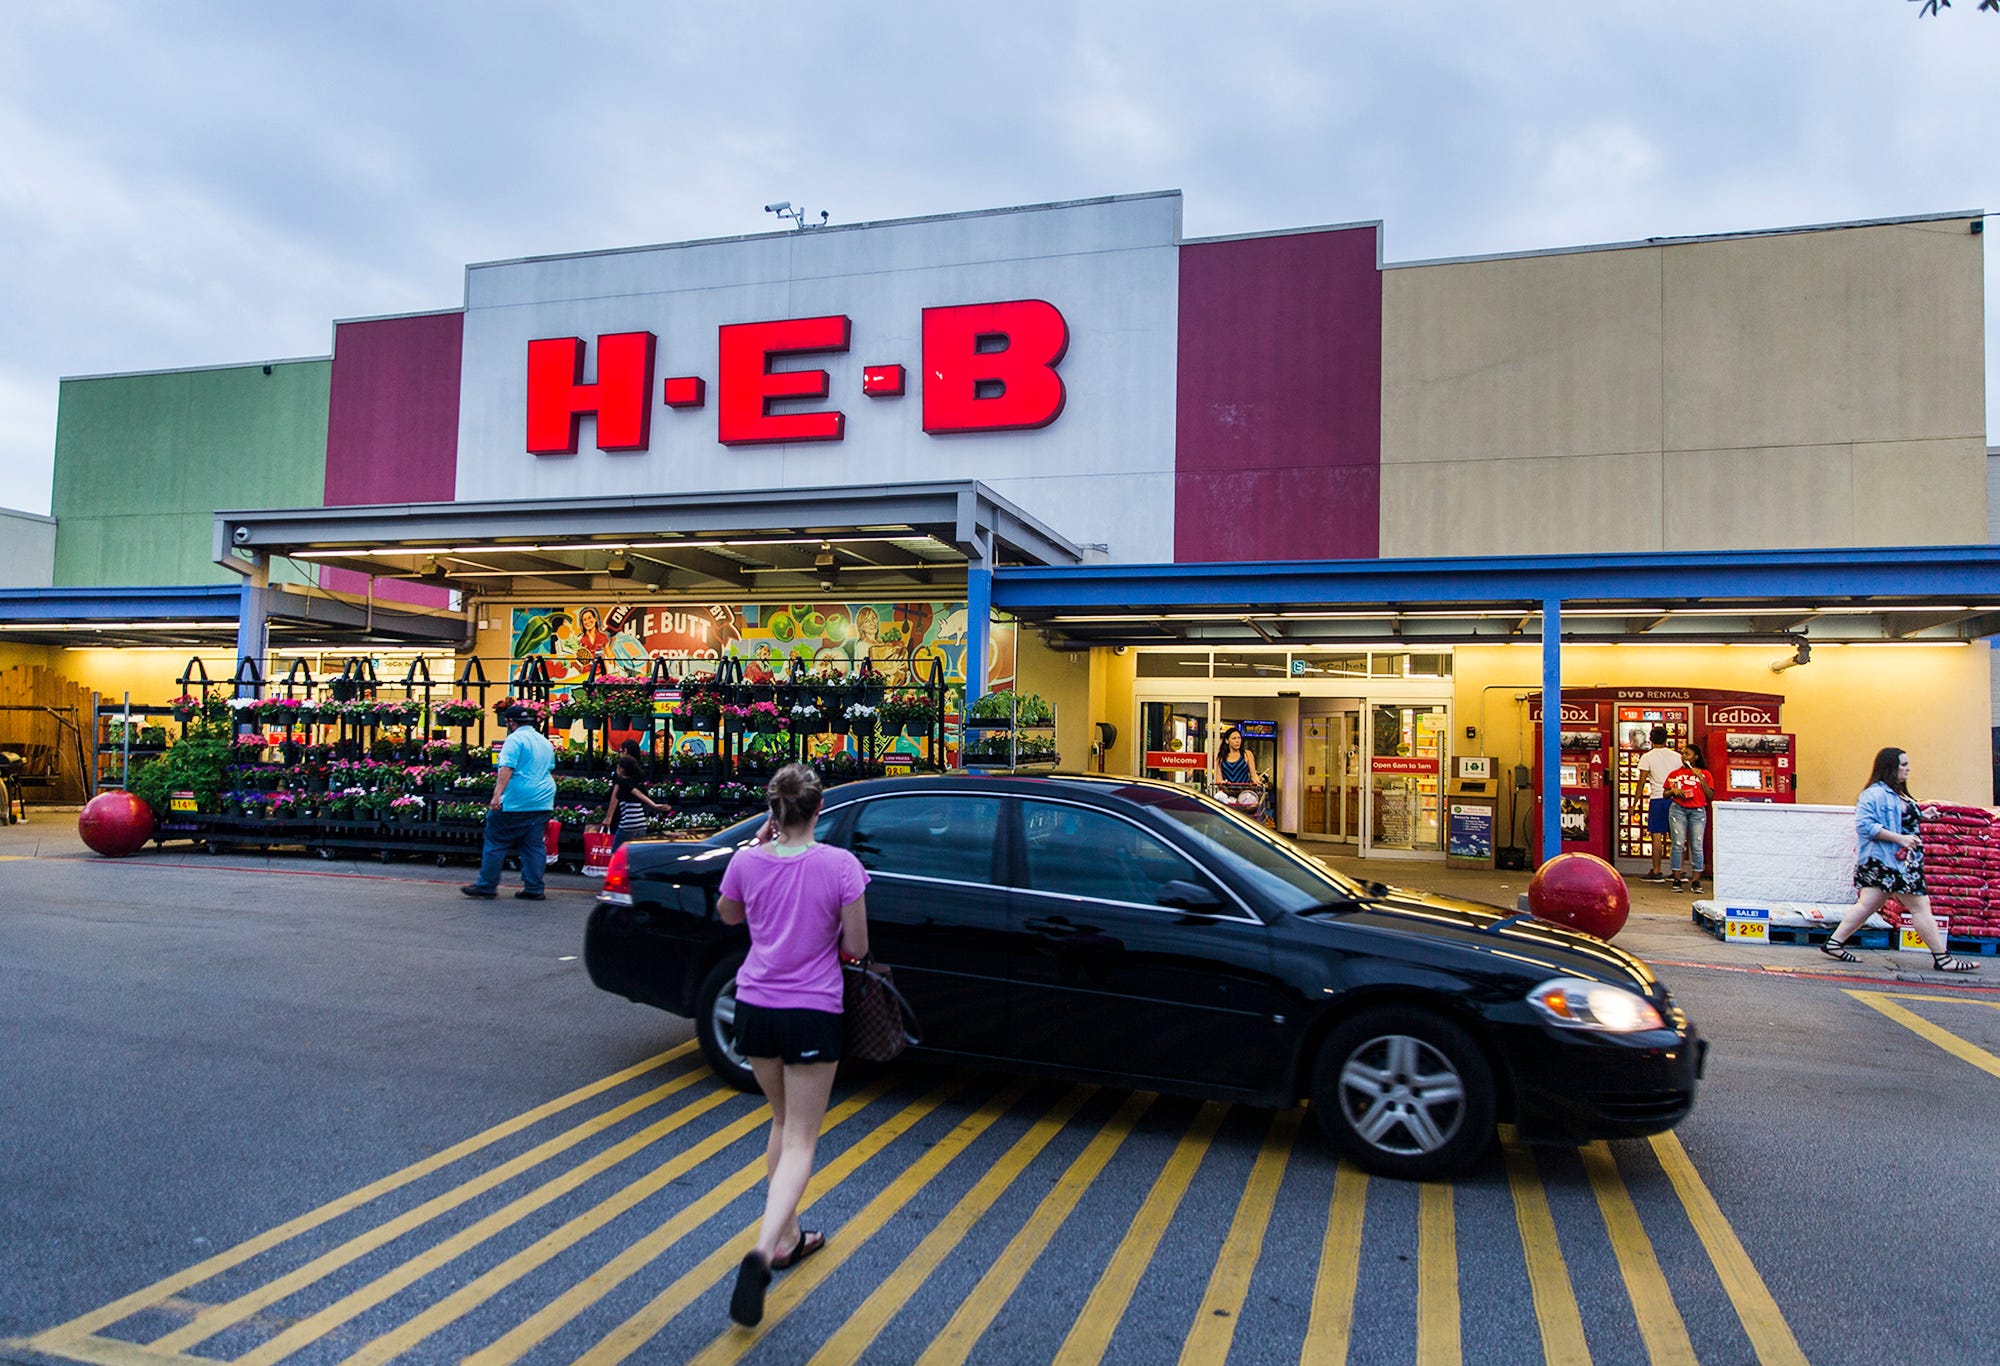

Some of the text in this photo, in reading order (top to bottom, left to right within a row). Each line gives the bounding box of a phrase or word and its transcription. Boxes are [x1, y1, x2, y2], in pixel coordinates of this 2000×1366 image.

[526, 298, 1070, 456] H-E-B
[643, 613, 658, 638] E.
[661, 611, 712, 644] BUTT
[649, 648, 689, 660] CERY
[1618, 691, 1690, 699] DVD RENTALS
[1533, 707, 1589, 720] rbox
[1712, 709, 1772, 723] redbox
[1161, 756, 1198, 764] Welcome
[1591, 754, 1602, 764] A
[1777, 757, 1789, 768] B
[1560, 813, 1585, 831] OOM
[1735, 909, 1759, 917] SALE!
[1906, 931, 1923, 945] $3
